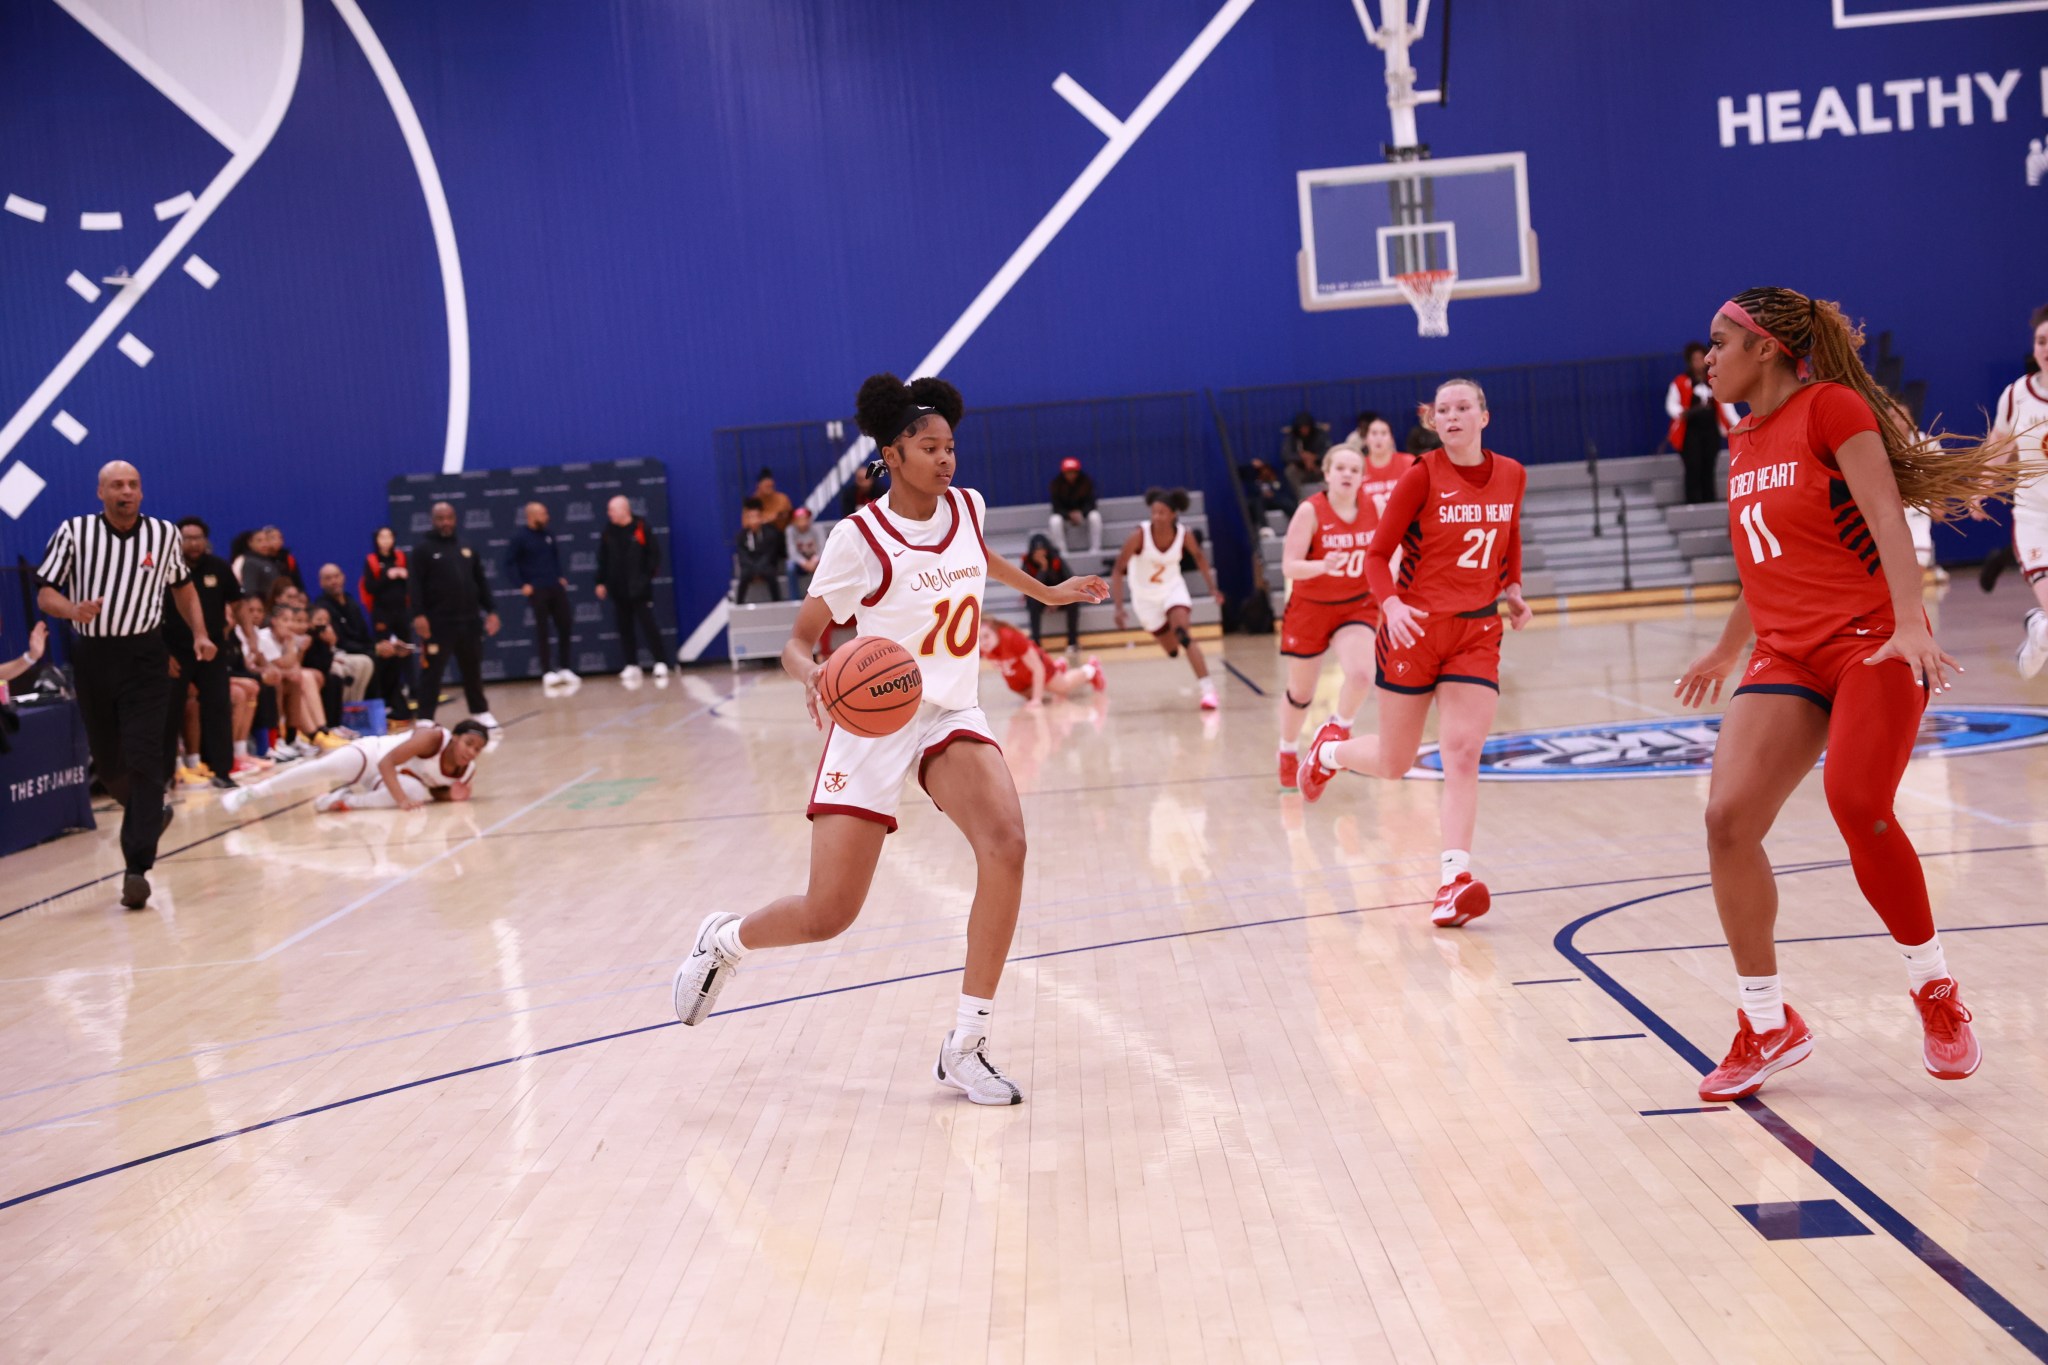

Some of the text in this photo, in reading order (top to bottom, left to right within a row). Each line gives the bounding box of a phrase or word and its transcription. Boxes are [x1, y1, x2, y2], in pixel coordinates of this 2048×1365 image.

[1718, 69, 2022, 148] HEALTHY
[1730, 461, 1798, 502] ACRED HEART
[1439, 503, 1514, 523] SACRED HEART
[1456, 528, 1498, 569] 21
[1740, 501, 1782, 564] 11
[911, 566, 981, 592] McNamara
[1149, 562, 1166, 584] 2
[919, 594, 980, 659] 10
[869, 667, 922, 698] Wilson
[10, 779, 34, 802] THE
